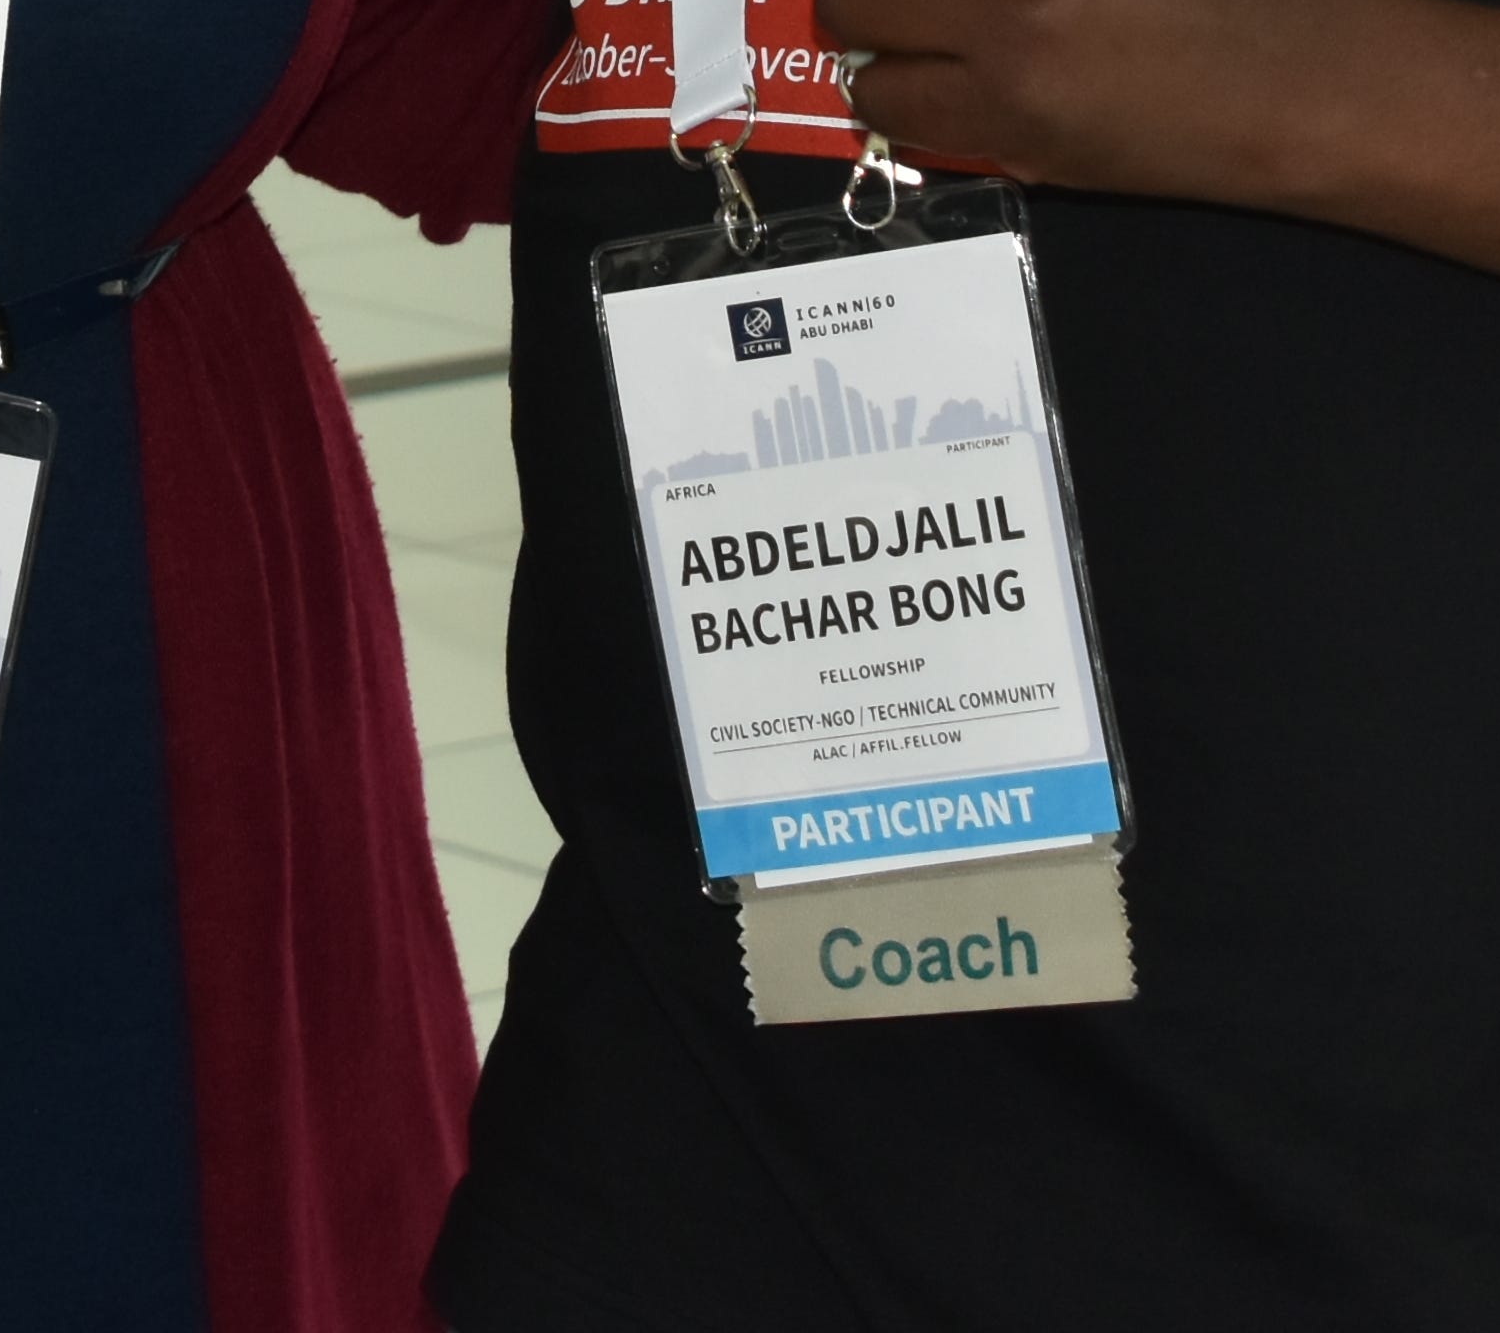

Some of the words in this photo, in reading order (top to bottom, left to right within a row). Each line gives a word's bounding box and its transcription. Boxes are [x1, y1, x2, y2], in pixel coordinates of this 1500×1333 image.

[800, 327, 828, 339] ABU
[831, 318, 874, 335] DHABI
[946, 436, 1011, 454] PARTICIPANT
[665, 483, 716, 502] AFRICA
[680, 494, 1025, 586] ABDELDJALIL
[691, 588, 879, 654] BACHAR
[891, 569, 1026, 628] BONG
[819, 657, 926, 686] FELLOWSHIP
[710, 726, 748, 743] CIVIL
[751, 708, 855, 738] SOCIETY-NGO
[868, 696, 955, 722] TECHNICAL
[959, 682, 1056, 709] COMMUNITY
[813, 744, 848, 761] ALAC
[860, 730, 962, 755] AFFIL.FELLOW
[771, 787, 1035, 851] PARTICIPANT
[818, 917, 1039, 990] Coach
